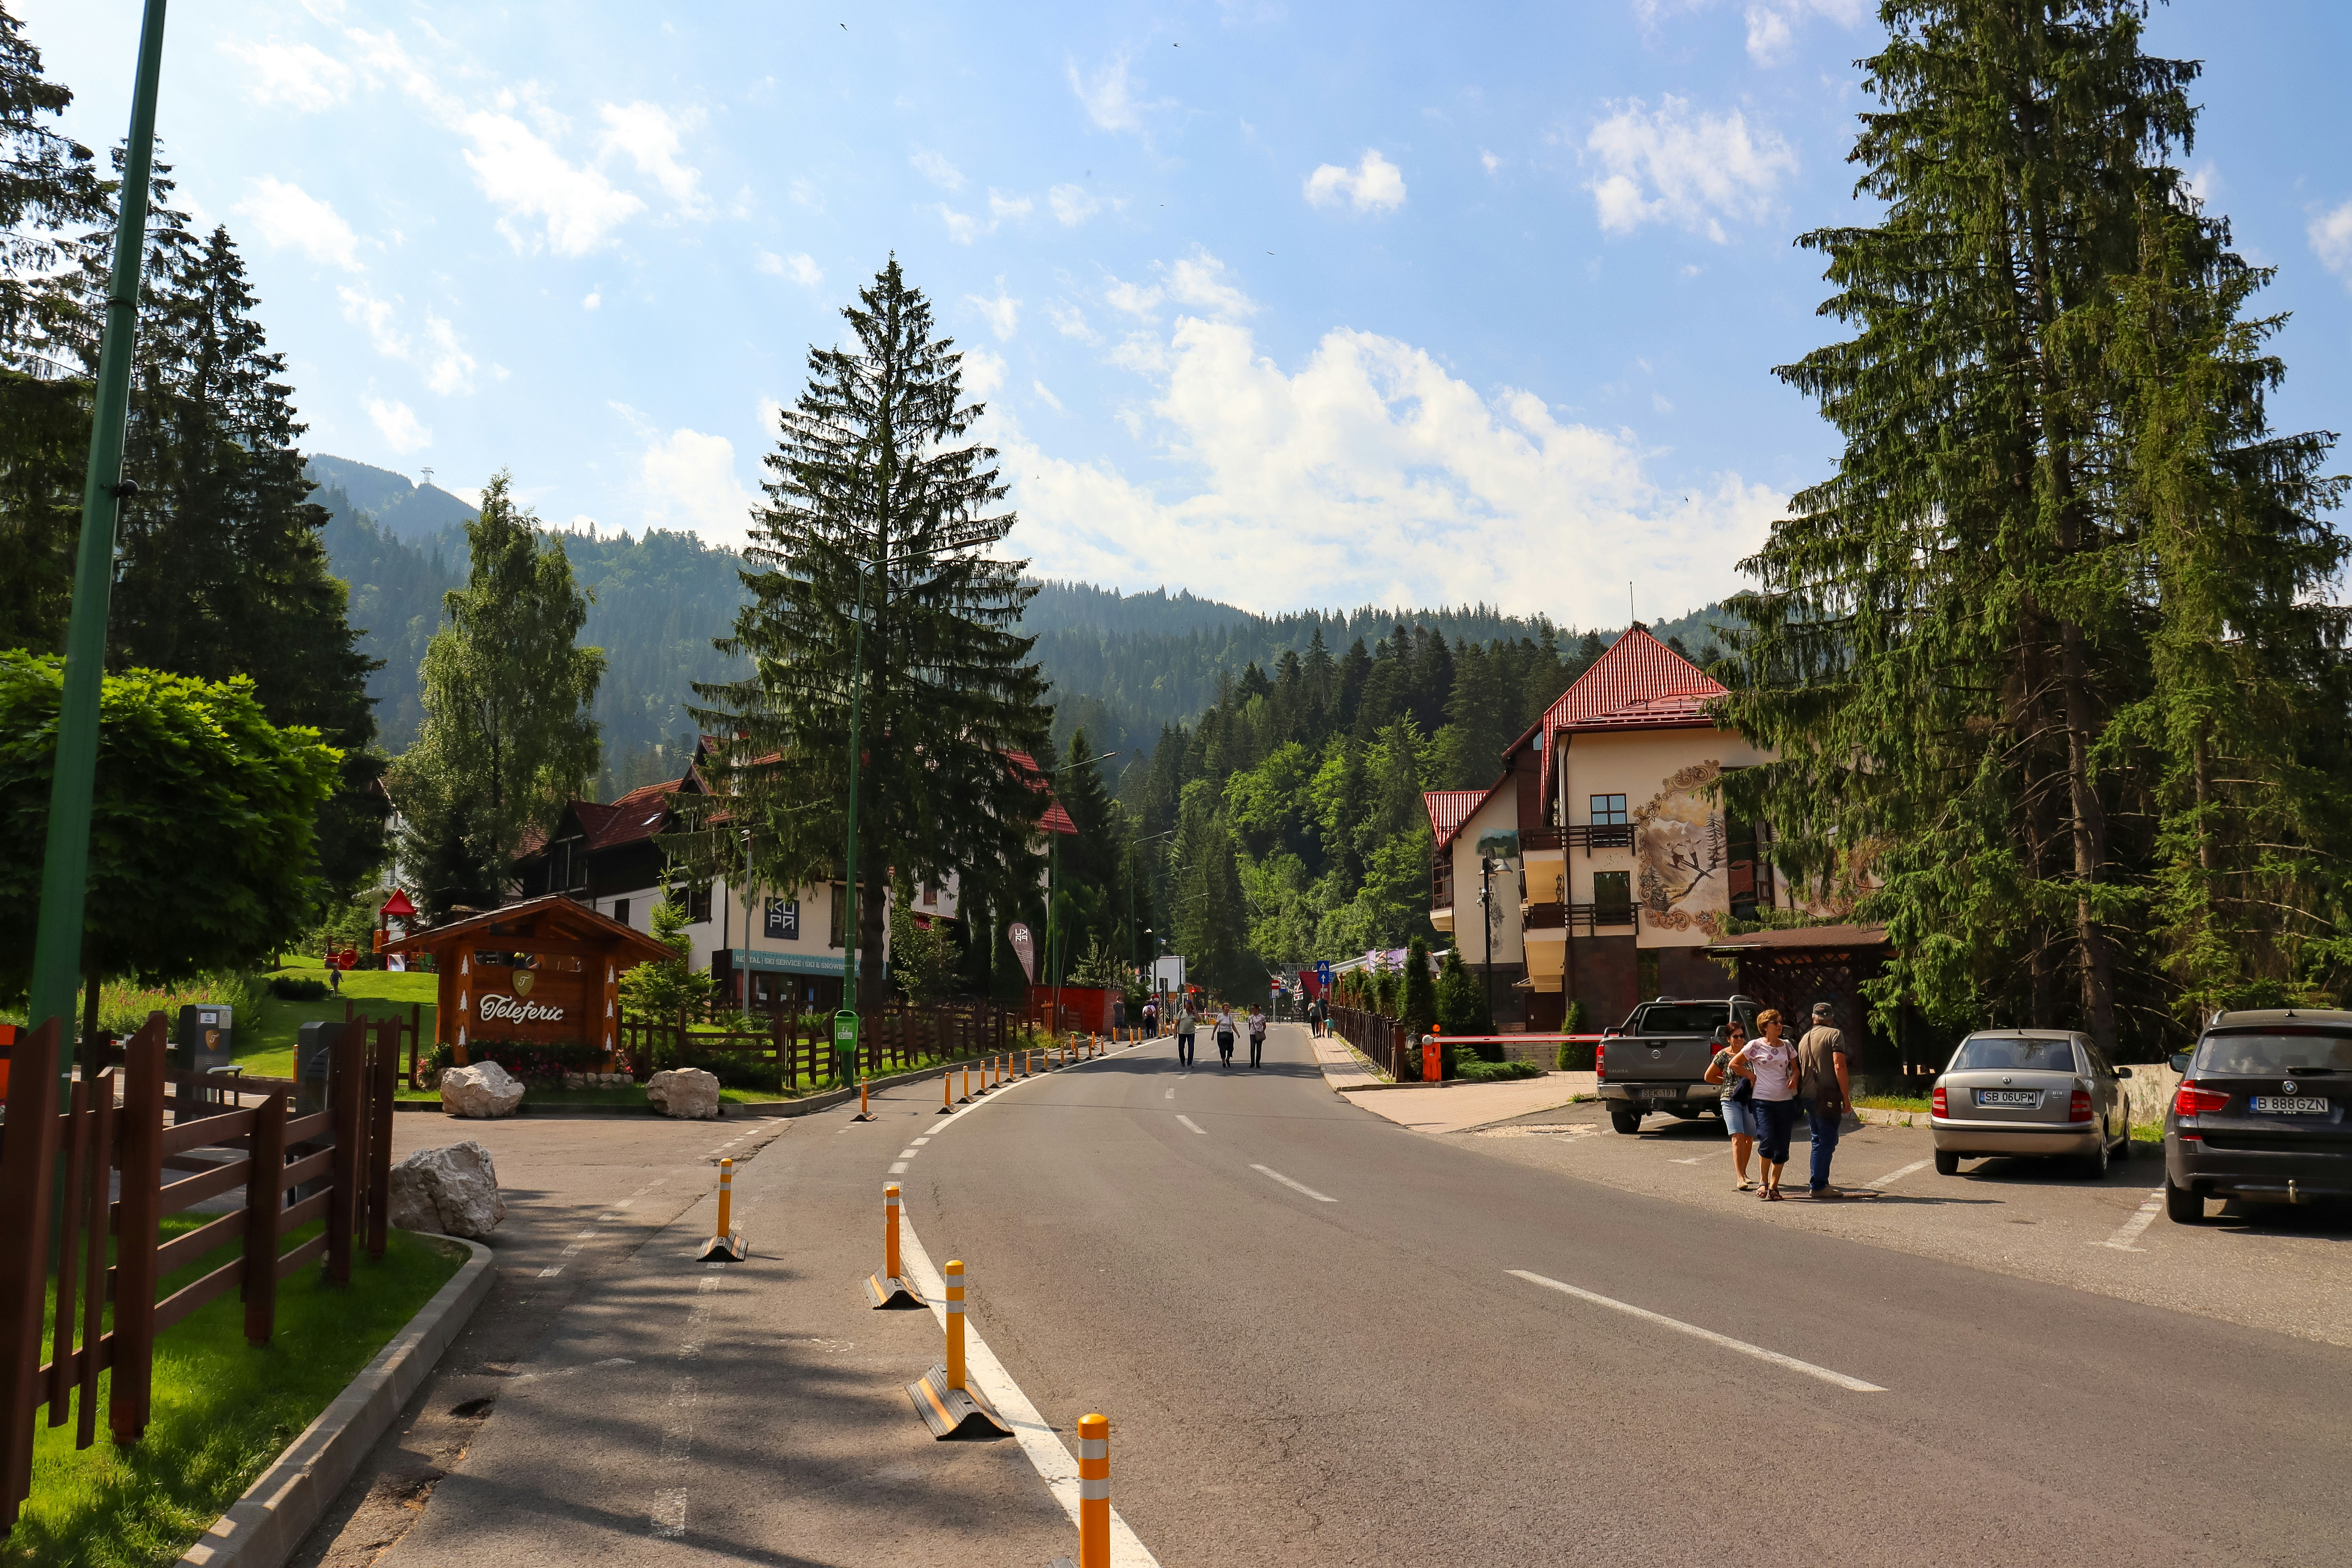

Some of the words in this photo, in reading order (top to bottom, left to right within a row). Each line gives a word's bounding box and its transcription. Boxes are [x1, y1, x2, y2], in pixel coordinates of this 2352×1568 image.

[770, 900, 795, 915] KU
[770, 915, 794, 929] PA
[821, 963, 858, 971] SNOWBD
[518, 975, 531, 987] T
[480, 994, 564, 1024] Teleferic
[209, 1033, 220, 1043] T
[1985, 1093, 1999, 1101] SB
[2002, 1093, 2034, 1102] 06UPM
[2258, 1098, 2267, 1109] B
